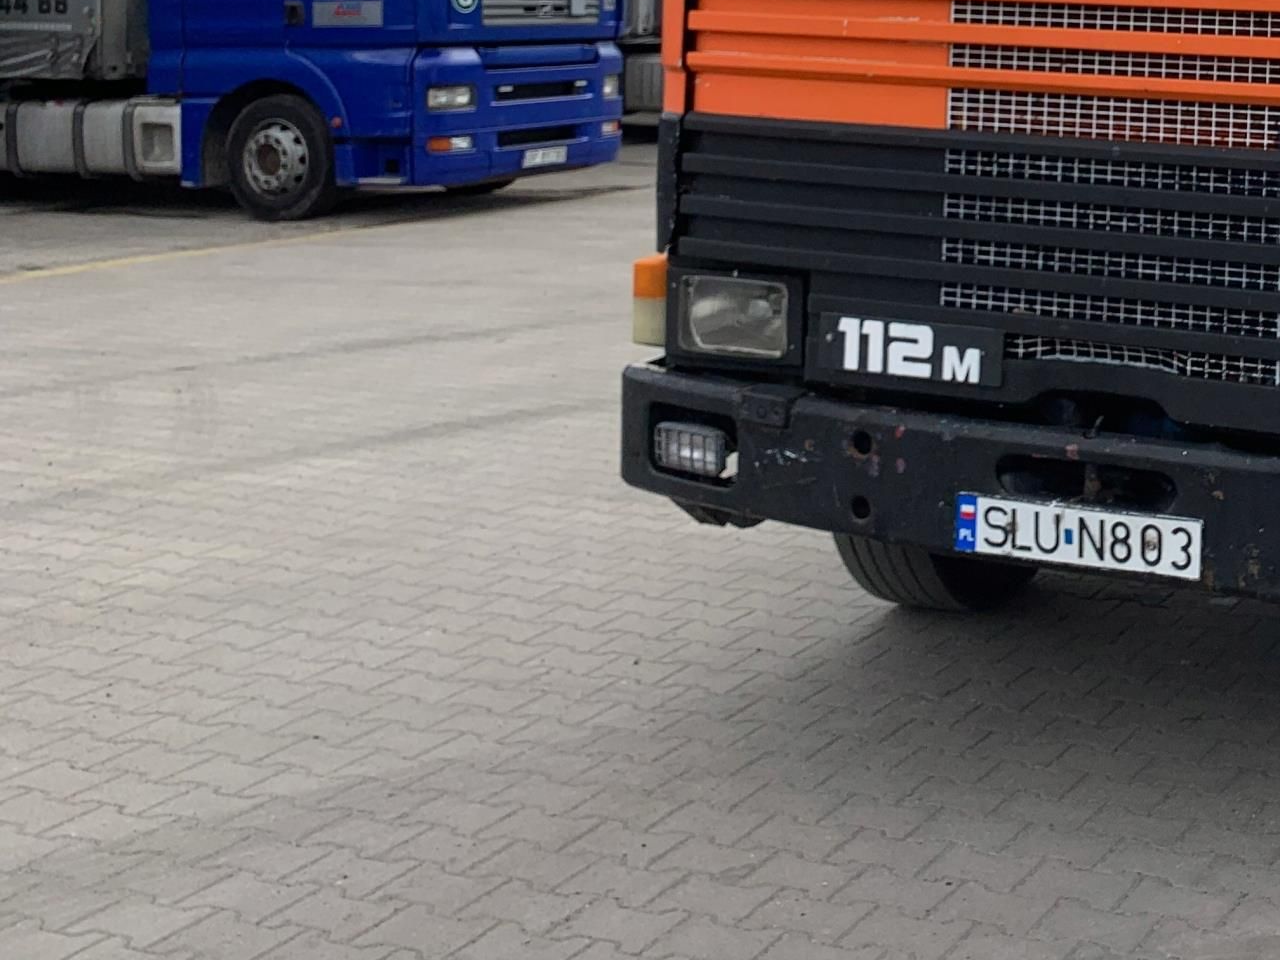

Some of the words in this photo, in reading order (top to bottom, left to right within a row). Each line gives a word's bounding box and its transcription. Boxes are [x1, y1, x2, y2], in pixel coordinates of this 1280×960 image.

[837, 316, 934, 378] 112
[942, 345, 981, 384] M
[958, 528, 974, 542] PL
[984, 506, 1060, 554] SLU
[1078, 516, 1192, 571] N803
